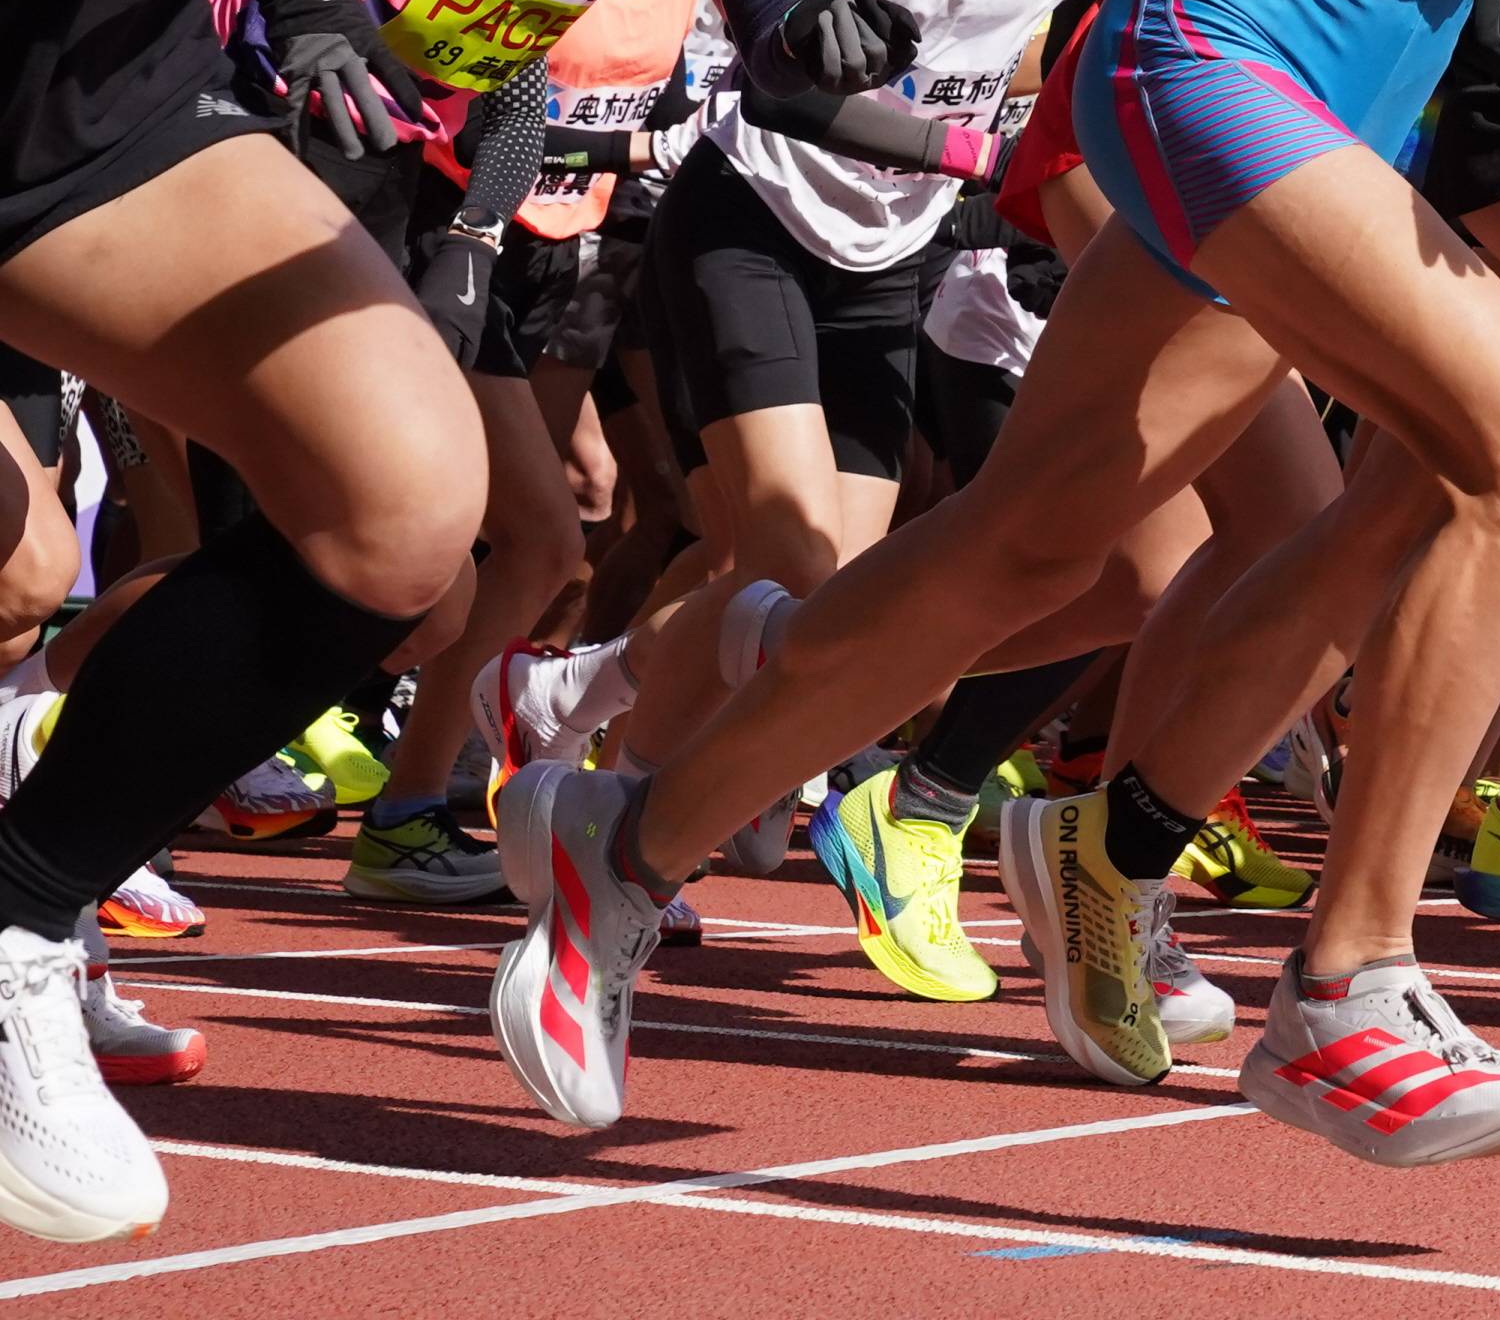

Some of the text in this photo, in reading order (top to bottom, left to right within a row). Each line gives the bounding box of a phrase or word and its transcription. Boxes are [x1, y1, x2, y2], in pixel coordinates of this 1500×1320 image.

[424, 39, 464, 67] 89
[1059, 805, 1082, 964] ON RUNNING
